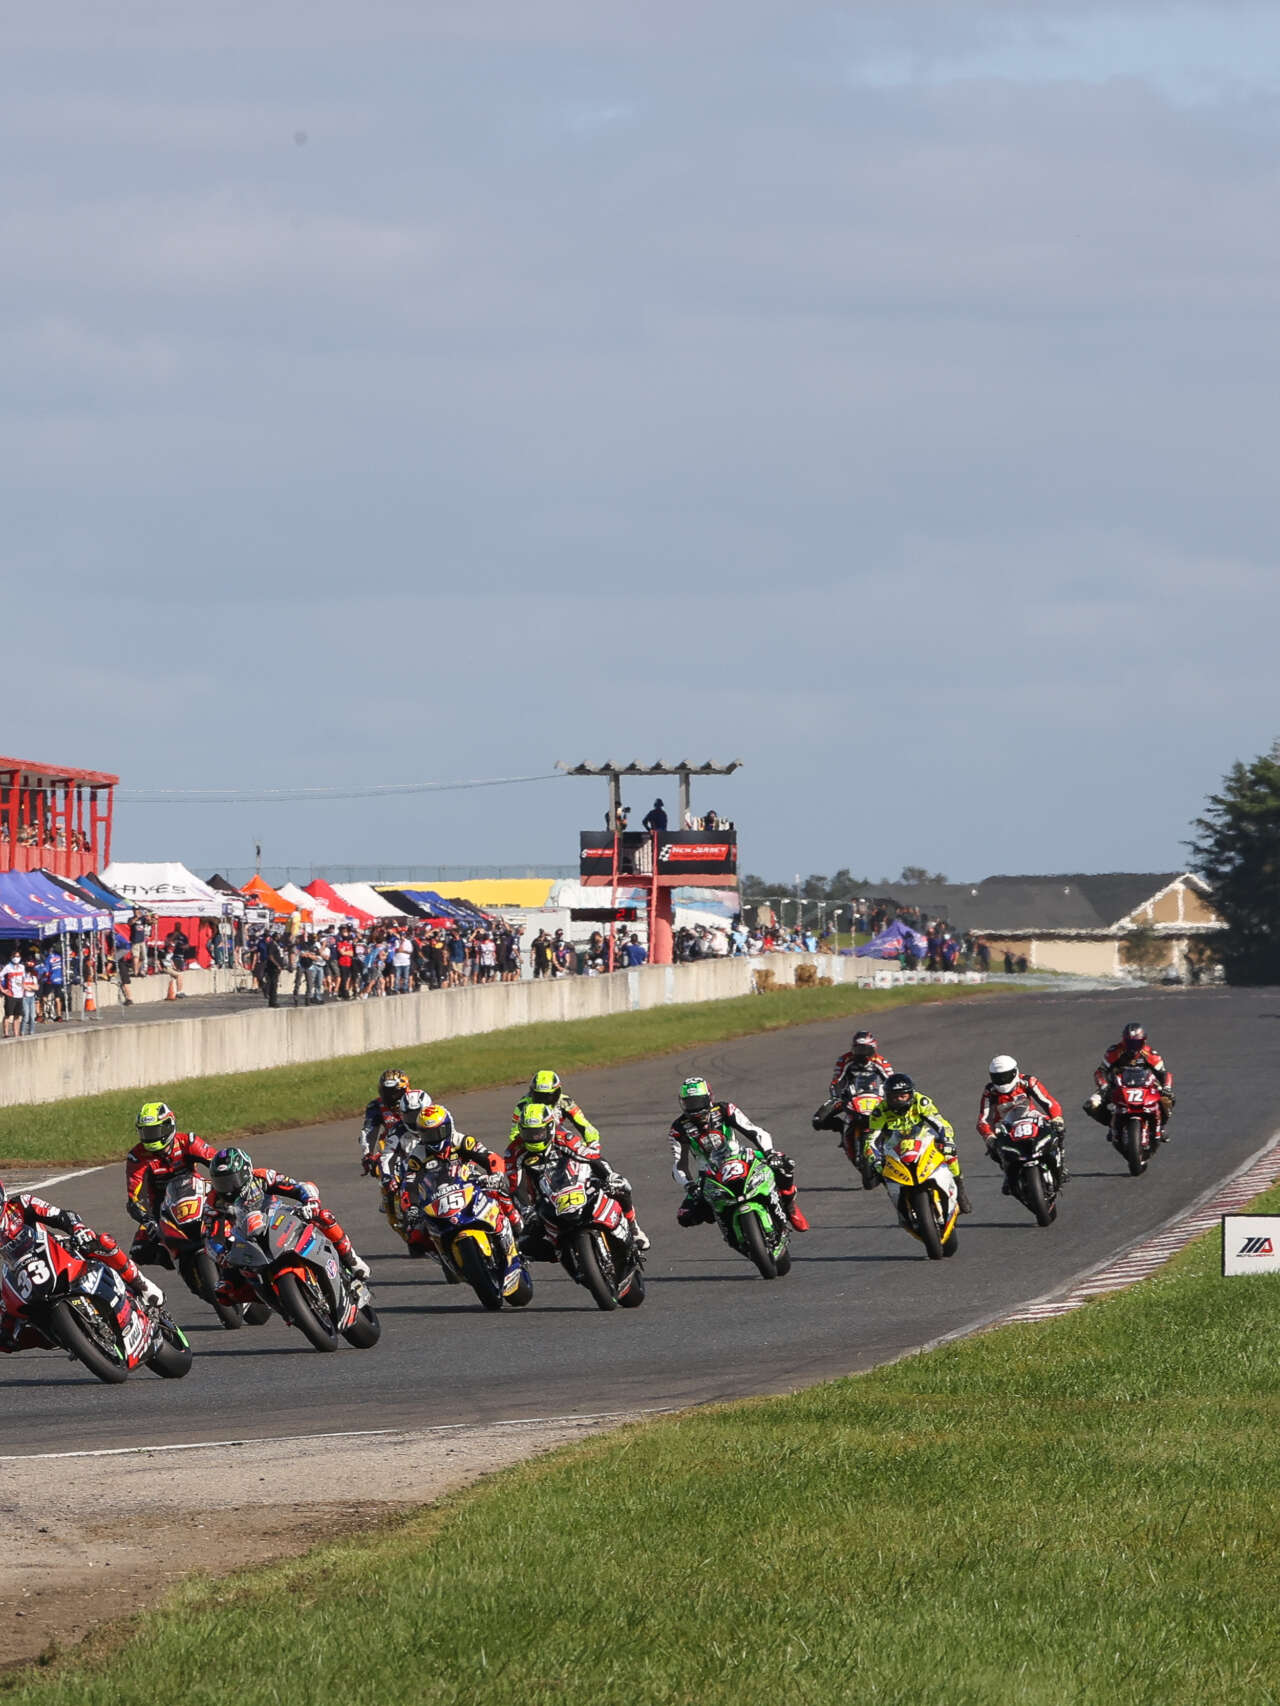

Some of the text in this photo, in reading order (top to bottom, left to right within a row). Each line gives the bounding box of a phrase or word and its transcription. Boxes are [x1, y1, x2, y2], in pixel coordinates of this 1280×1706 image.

[1126, 1090, 1144, 1102] 72
[1013, 1124, 1033, 1137] 48
[721, 1162, 744, 1182] 23
[438, 1192, 465, 1215] 45
[556, 1190, 586, 1213] 25
[17, 1260, 51, 1299] 33
